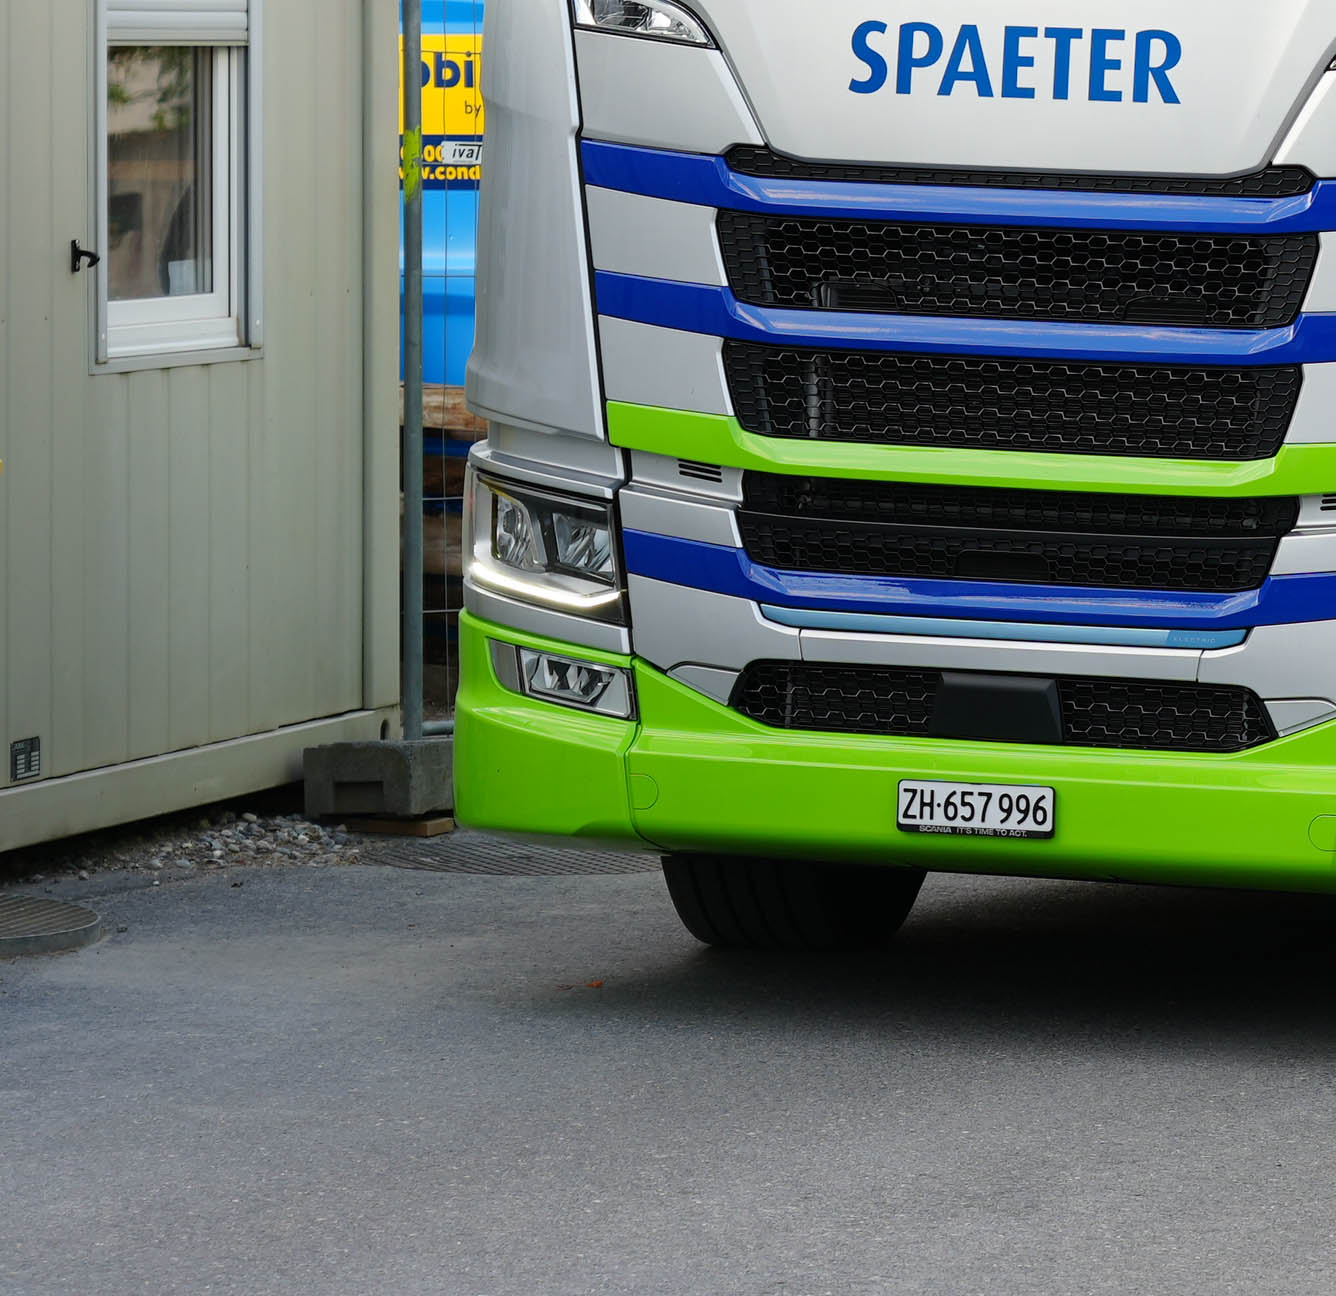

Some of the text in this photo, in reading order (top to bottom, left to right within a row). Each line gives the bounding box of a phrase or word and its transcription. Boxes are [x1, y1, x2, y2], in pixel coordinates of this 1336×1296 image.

[848, 20, 1182, 104] SPAETER
[465, 100, 481, 118] by
[919, 825, 1028, 838] SCANIA IT'S TIME TO ACT.
